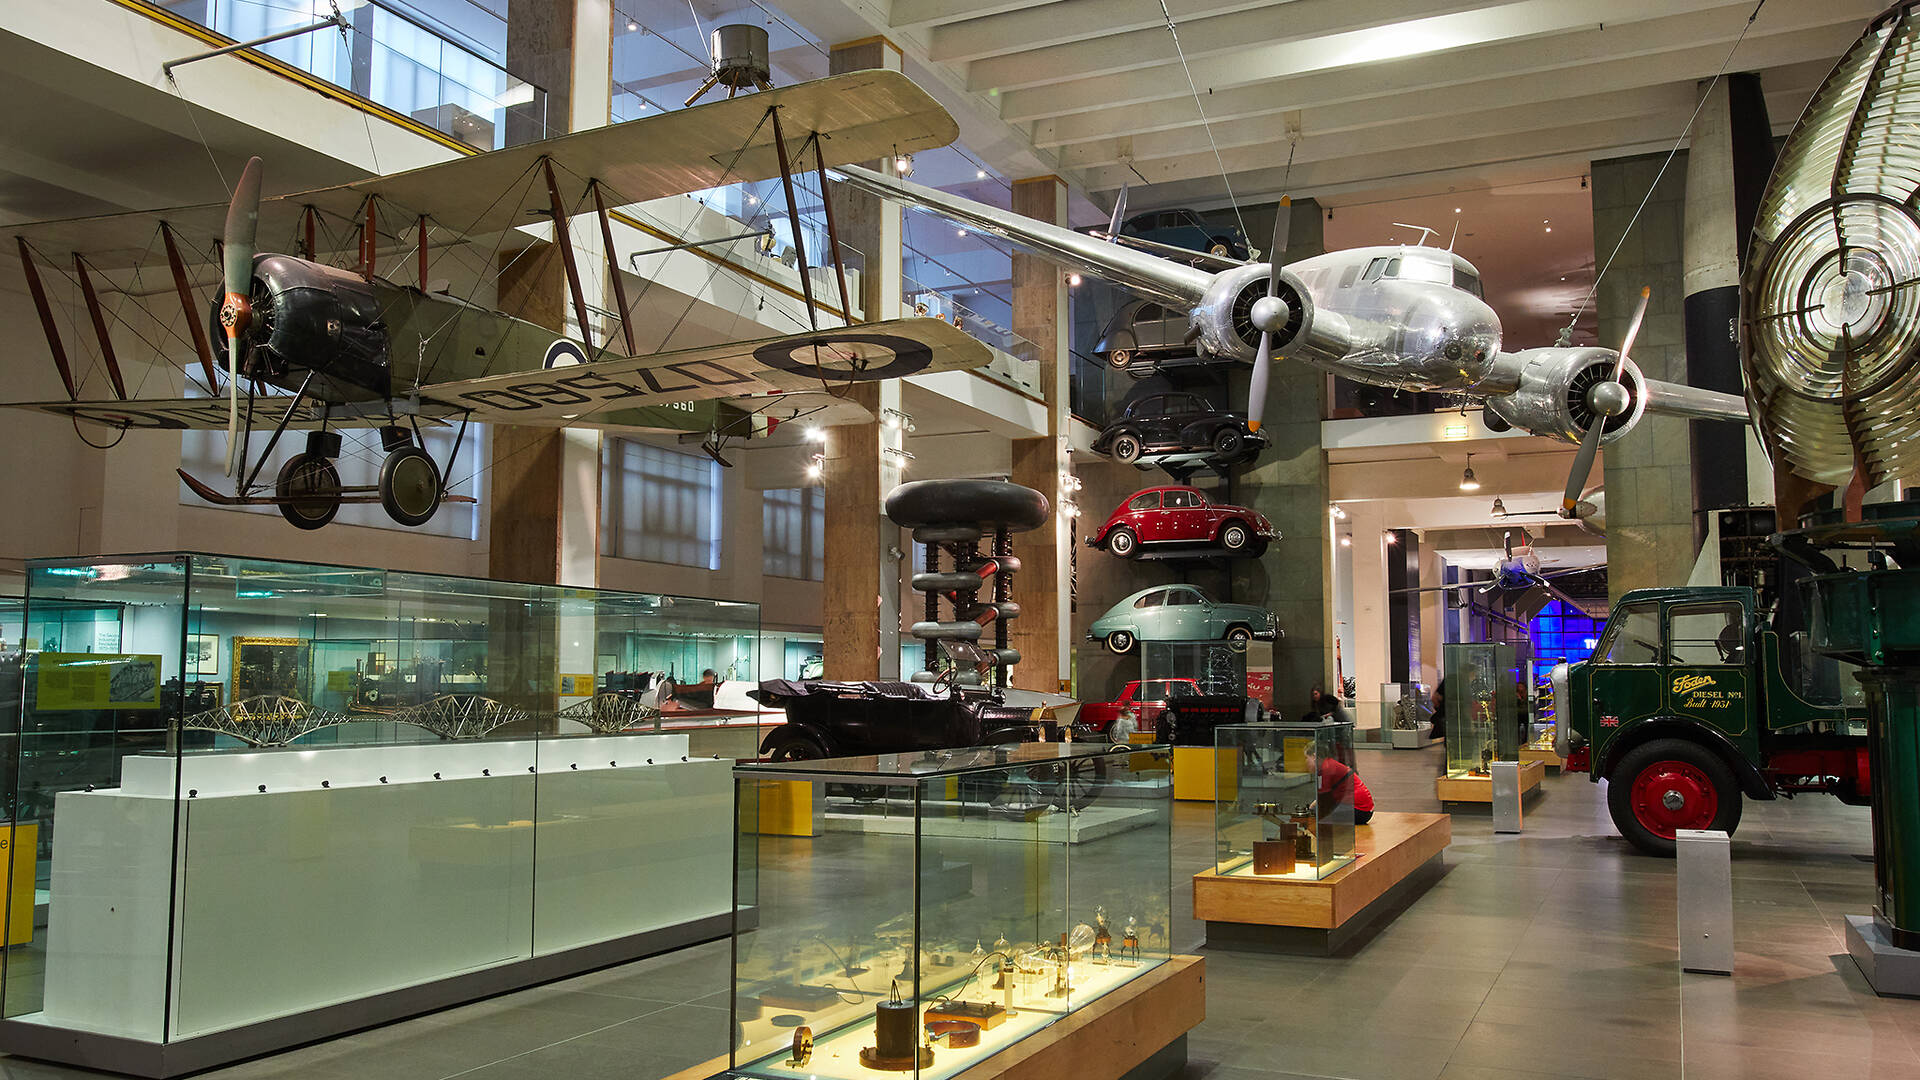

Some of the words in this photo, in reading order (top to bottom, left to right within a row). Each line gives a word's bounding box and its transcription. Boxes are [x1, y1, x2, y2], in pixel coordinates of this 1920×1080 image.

[1672, 674, 1717, 694] Foden
[1692, 691, 1725, 699] DIESEL
[1683, 697, 1708, 708] Built
